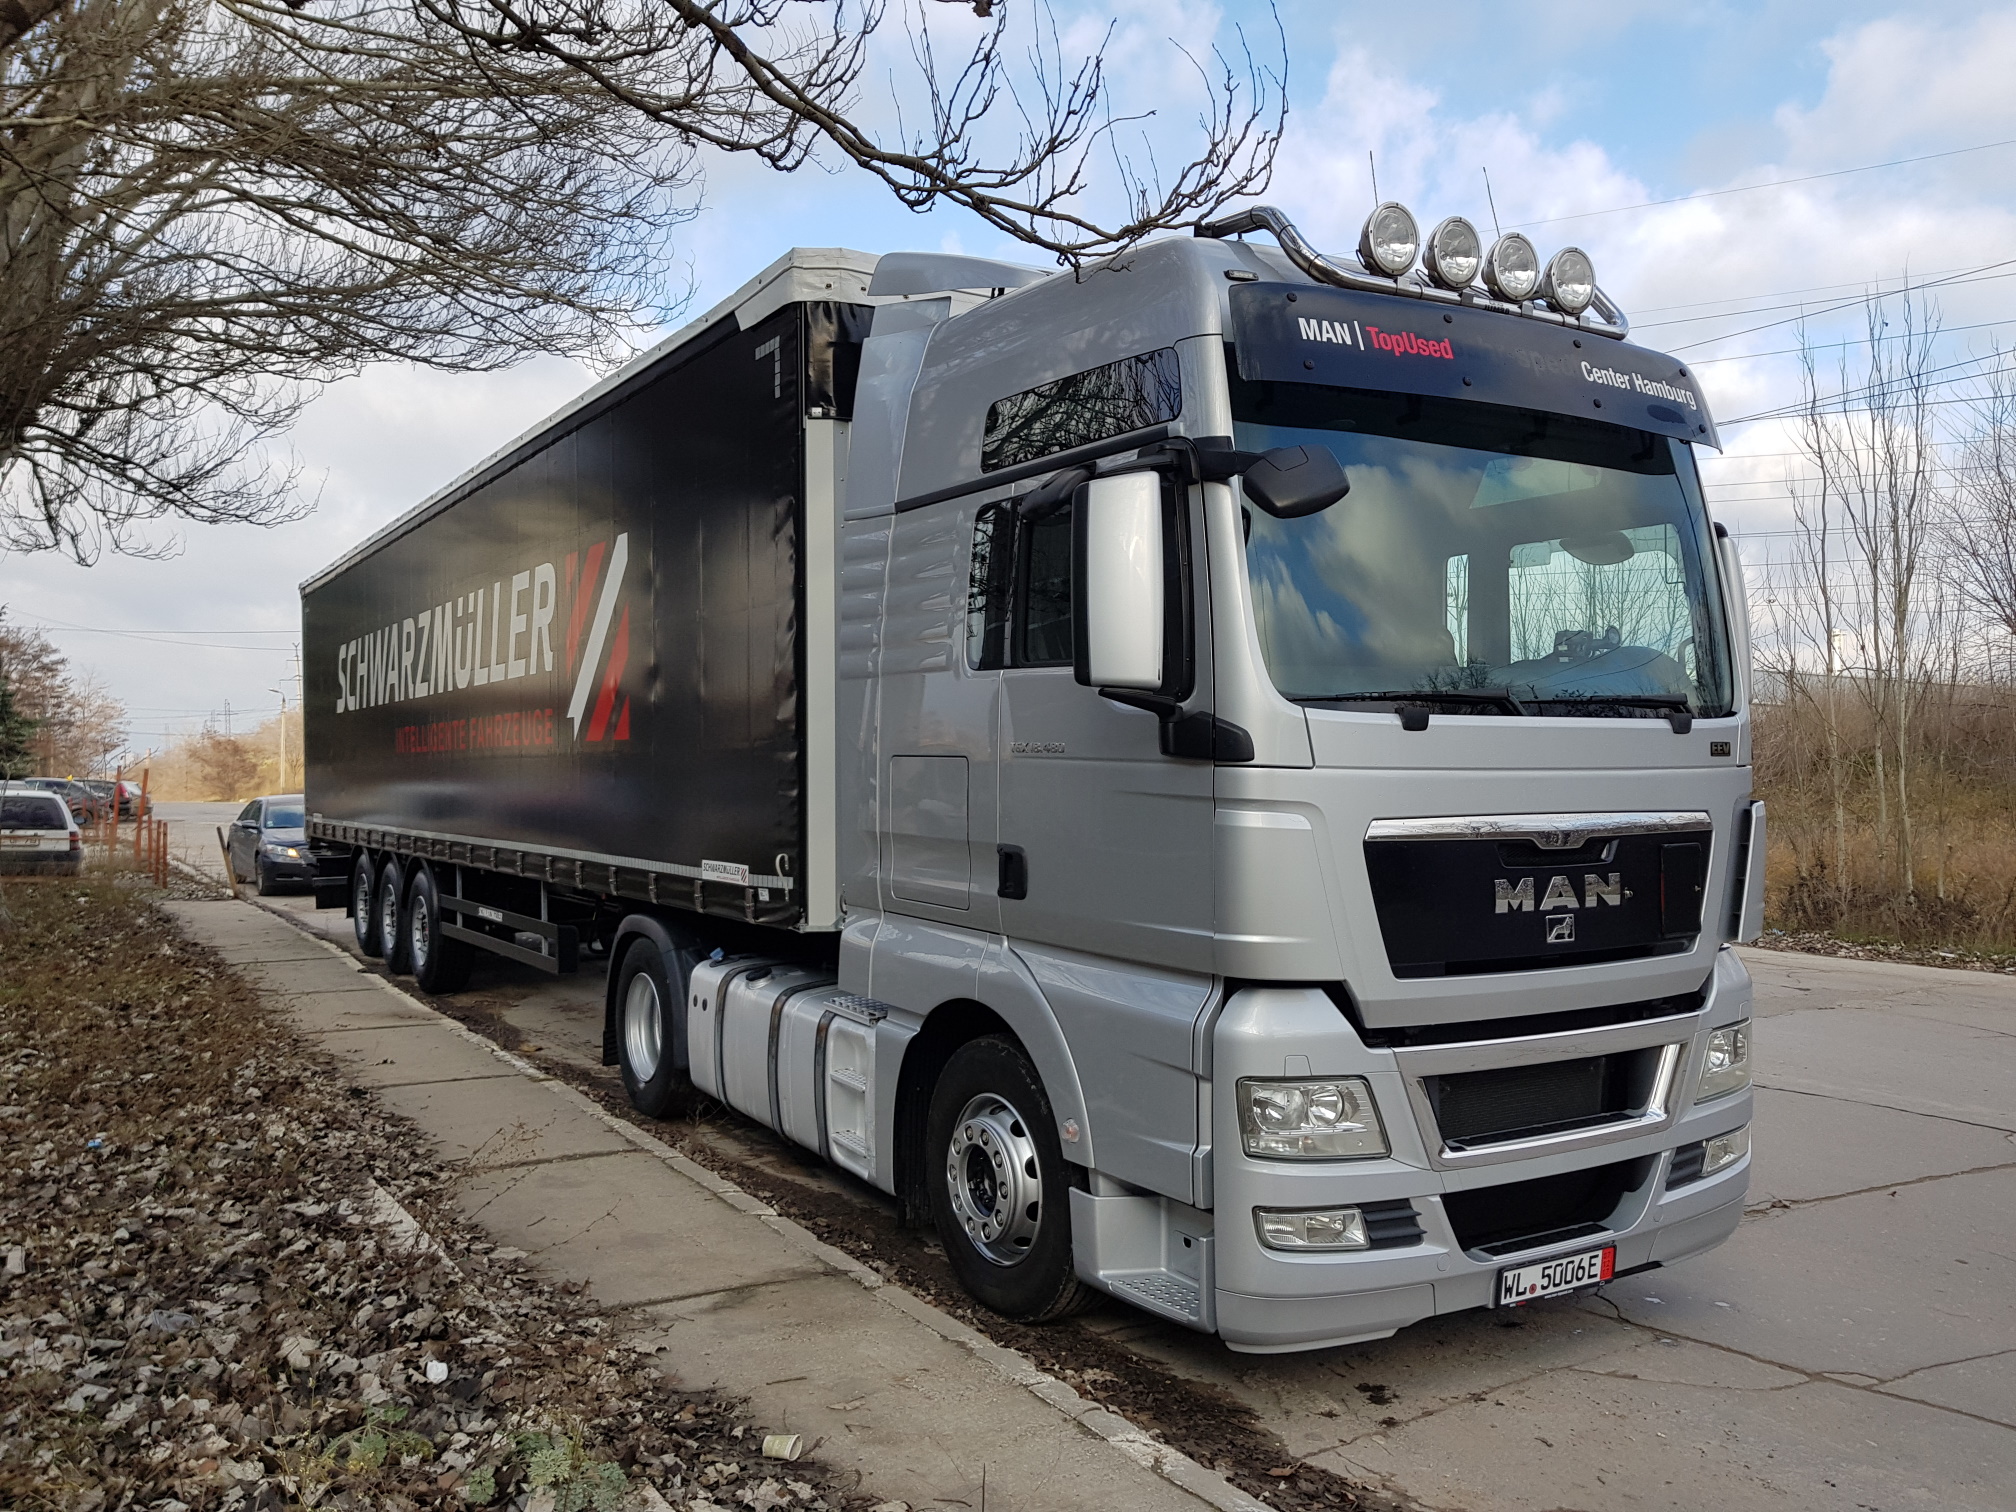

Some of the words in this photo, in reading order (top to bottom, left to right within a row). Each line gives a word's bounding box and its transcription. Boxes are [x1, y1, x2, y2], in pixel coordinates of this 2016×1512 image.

[1298, 317, 1352, 346] MAN
[1365, 326, 1455, 360] TopUsed
[1580, 360, 1631, 390] Center
[1631, 372, 1698, 412] Hamburg
[336, 562, 556, 714] SCHWARZMÜLLER
[470, 708, 554, 750] FAHRZEUGE
[1711, 742, 1730, 755] EEV
[1494, 872, 1621, 914] MAN
[1504, 1273, 1527, 1300] WL
[1541, 1254, 1599, 1290] 5006E
